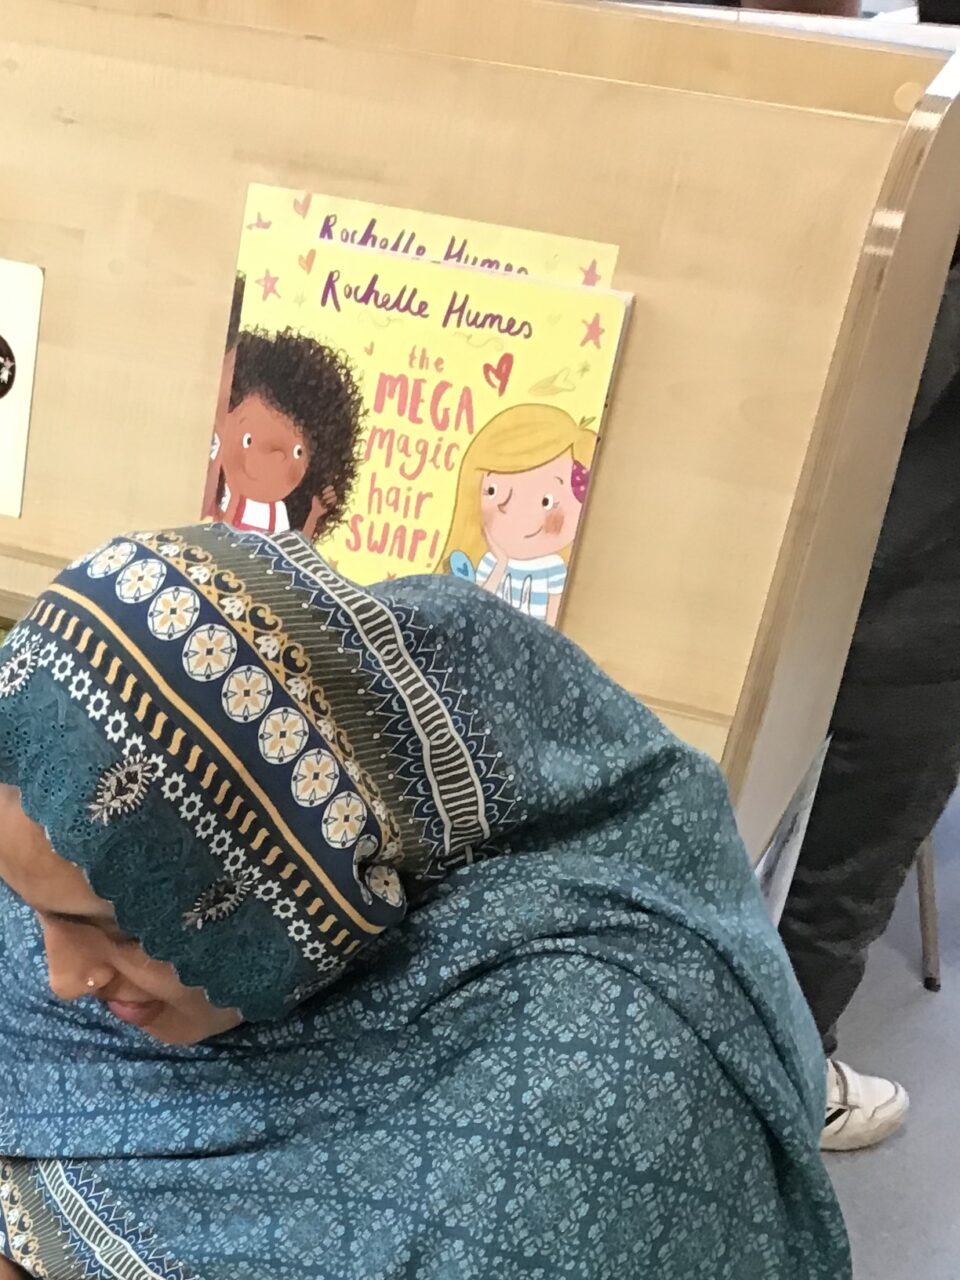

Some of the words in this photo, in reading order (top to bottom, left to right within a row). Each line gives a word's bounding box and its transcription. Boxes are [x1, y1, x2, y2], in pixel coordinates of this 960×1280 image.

[321, 270, 429, 318] Rochelle
[442, 291, 533, 339] Humes
[408, 345, 444, 373] the
[373, 372, 475, 435] MEGA
[367, 472, 434, 520] hair
[345, 514, 440, 568] SWAP!
